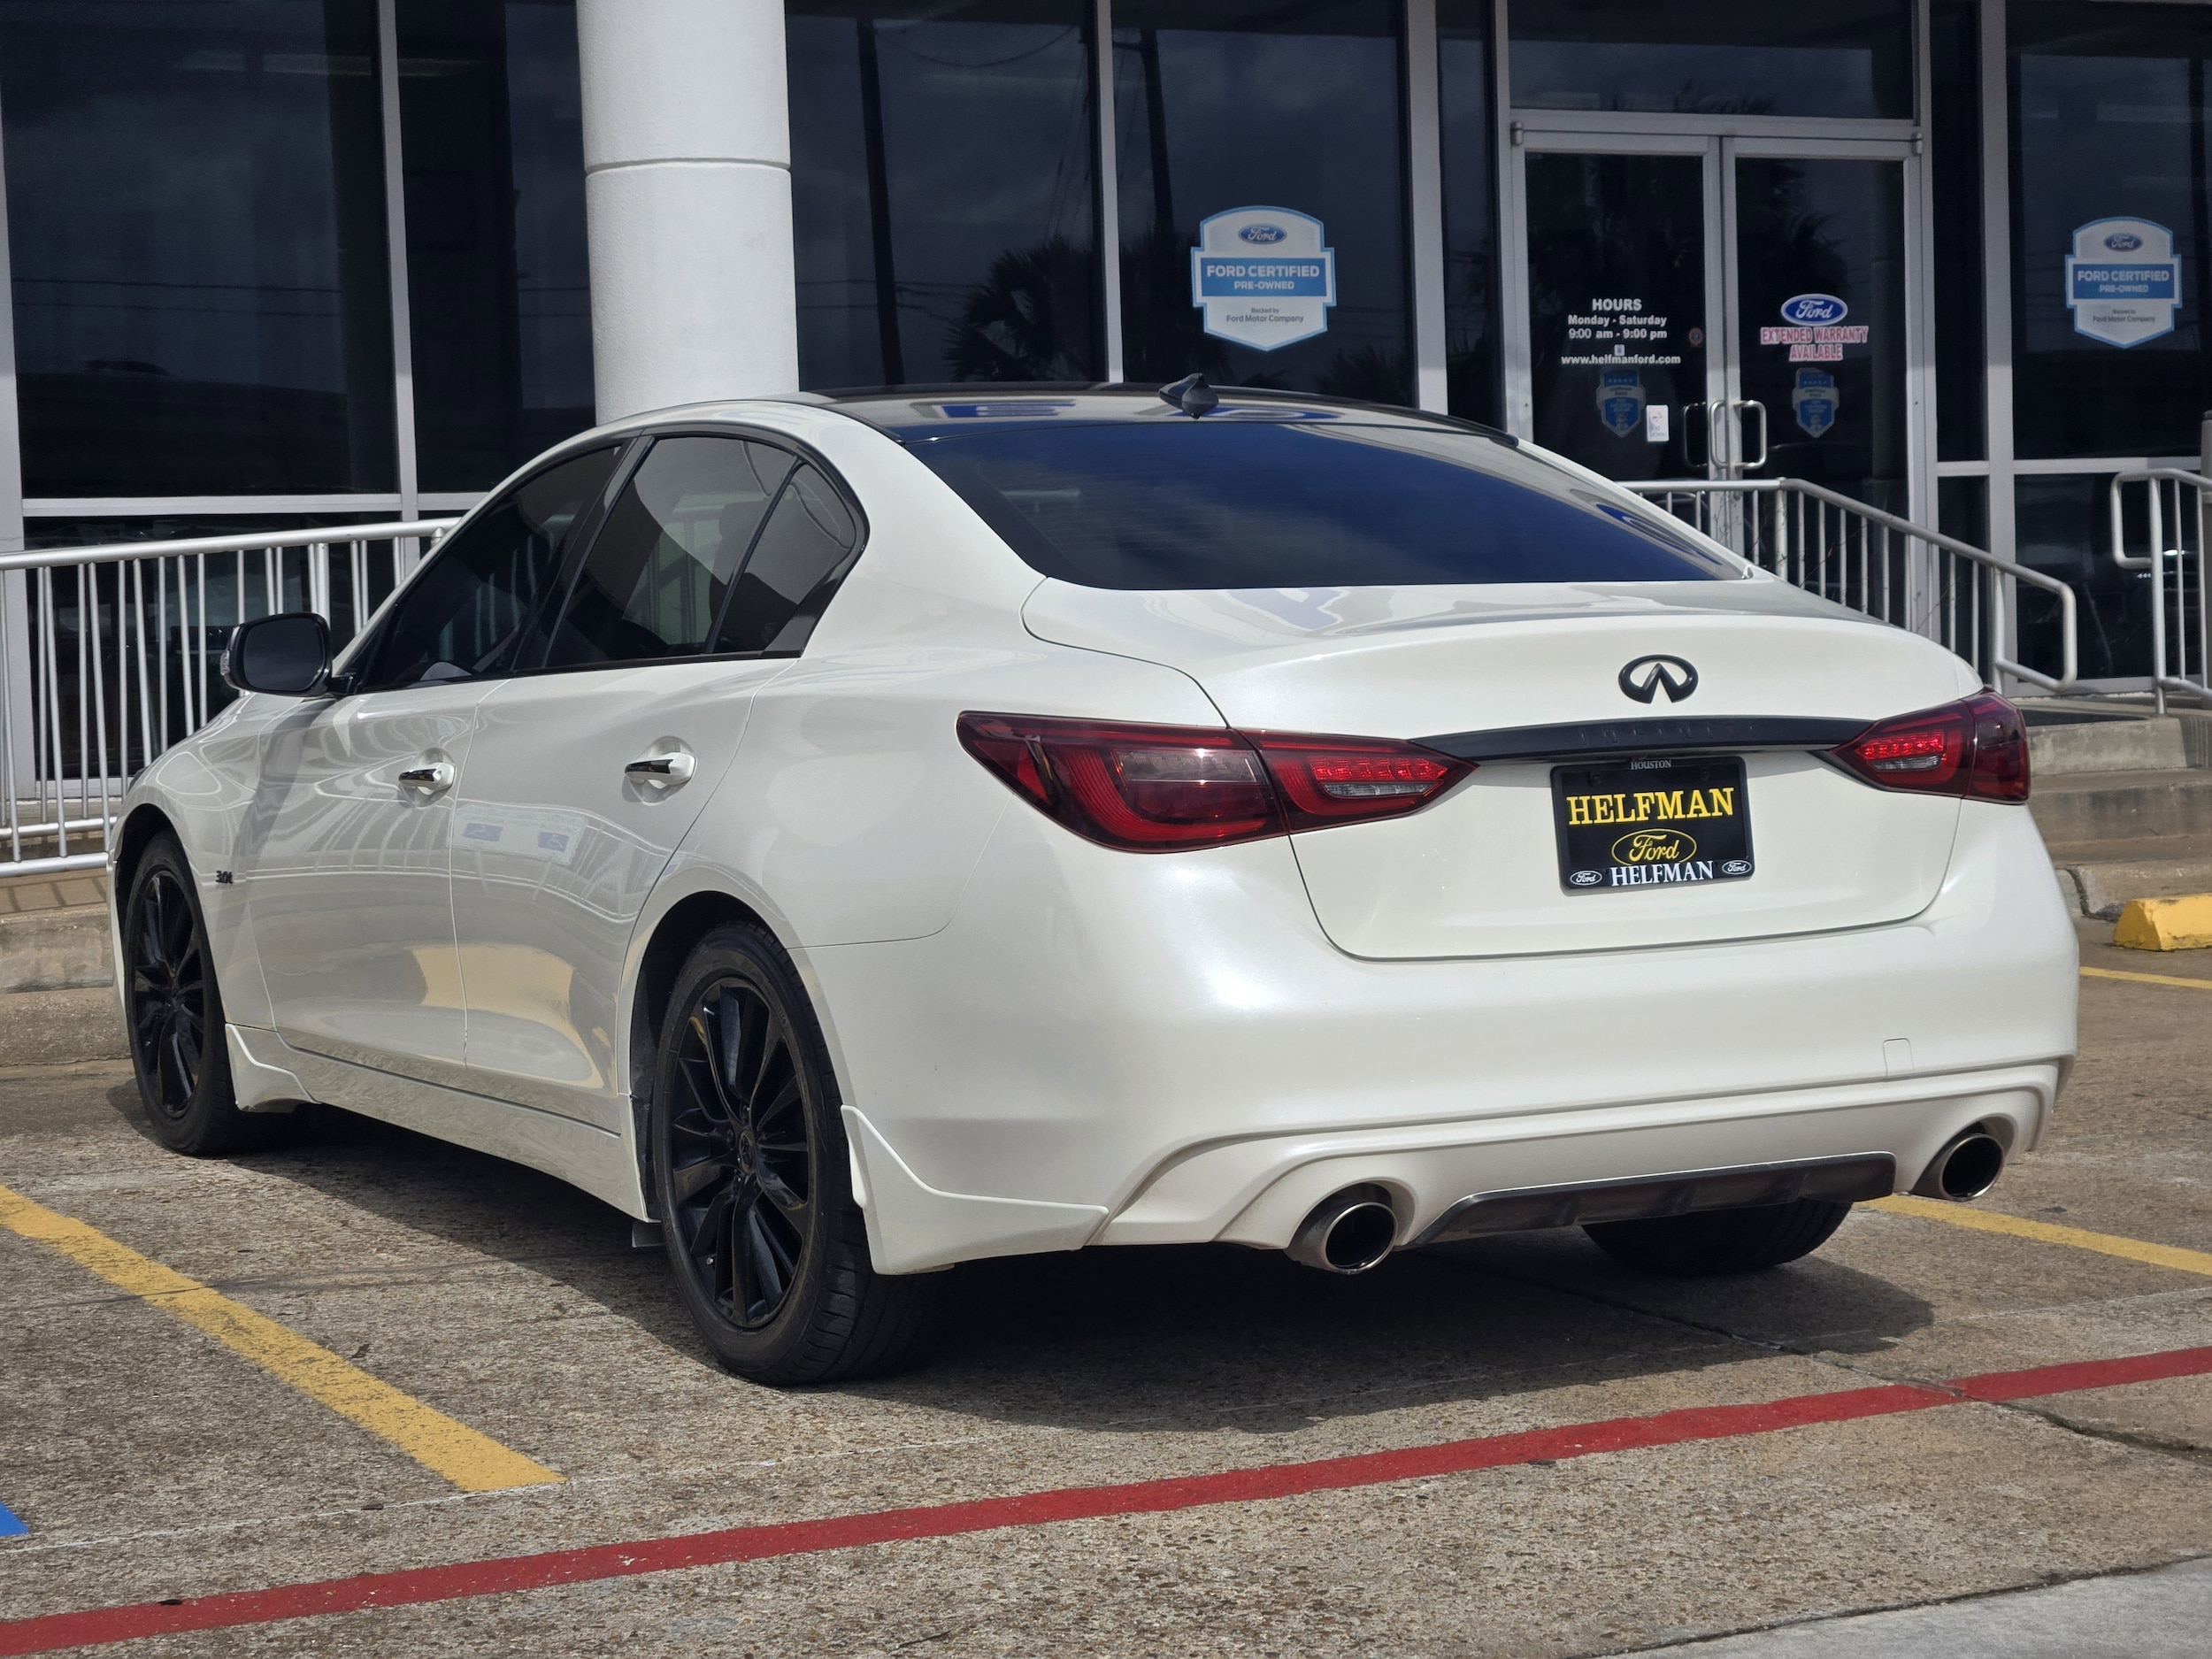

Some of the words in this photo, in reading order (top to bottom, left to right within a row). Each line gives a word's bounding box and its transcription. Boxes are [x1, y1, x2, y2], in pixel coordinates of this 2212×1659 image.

[1248, 227, 1277, 241] Ford
[2111, 236, 2134, 249] Ford
[1207, 265, 1246, 278] FORD
[1248, 265, 1320, 278] CERTIFIED
[2078, 270, 2109, 281] FORD
[2110, 270, 2170, 281] CERTIFIED
[1233, 280, 1295, 290] PRE-OWNED
[2099, 284, 2149, 293] PRE-OWNED
[1592, 298, 1642, 311] HOURS
[1795, 299, 1834, 319] Ford
[1269, 314, 1304, 324] Company
[1568, 315, 1610, 326] Monday
[1618, 315, 1667, 326] Saturday
[1569, 328, 1592, 339] 9:00
[1595, 330, 1614, 339] am
[1623, 328, 1647, 339] 9:00
[1649, 330, 1668, 341] pm
[1762, 328, 1812, 342] EXTENDED
[1815, 327, 1868, 342] WARRANTY
[1791, 344, 1842, 359] AVAILABLE
[1561, 354, 1681, 365] www.helfmanford.com
[1631, 759, 1672, 770] HOUSTON
[1566, 787, 1735, 825] HELFMAN
[1629, 833, 1680, 862] Ford
[1576, 872, 1596, 883] Ford
[1610, 860, 1715, 887] HELFMAN
[1727, 861, 1747, 872] Ford
